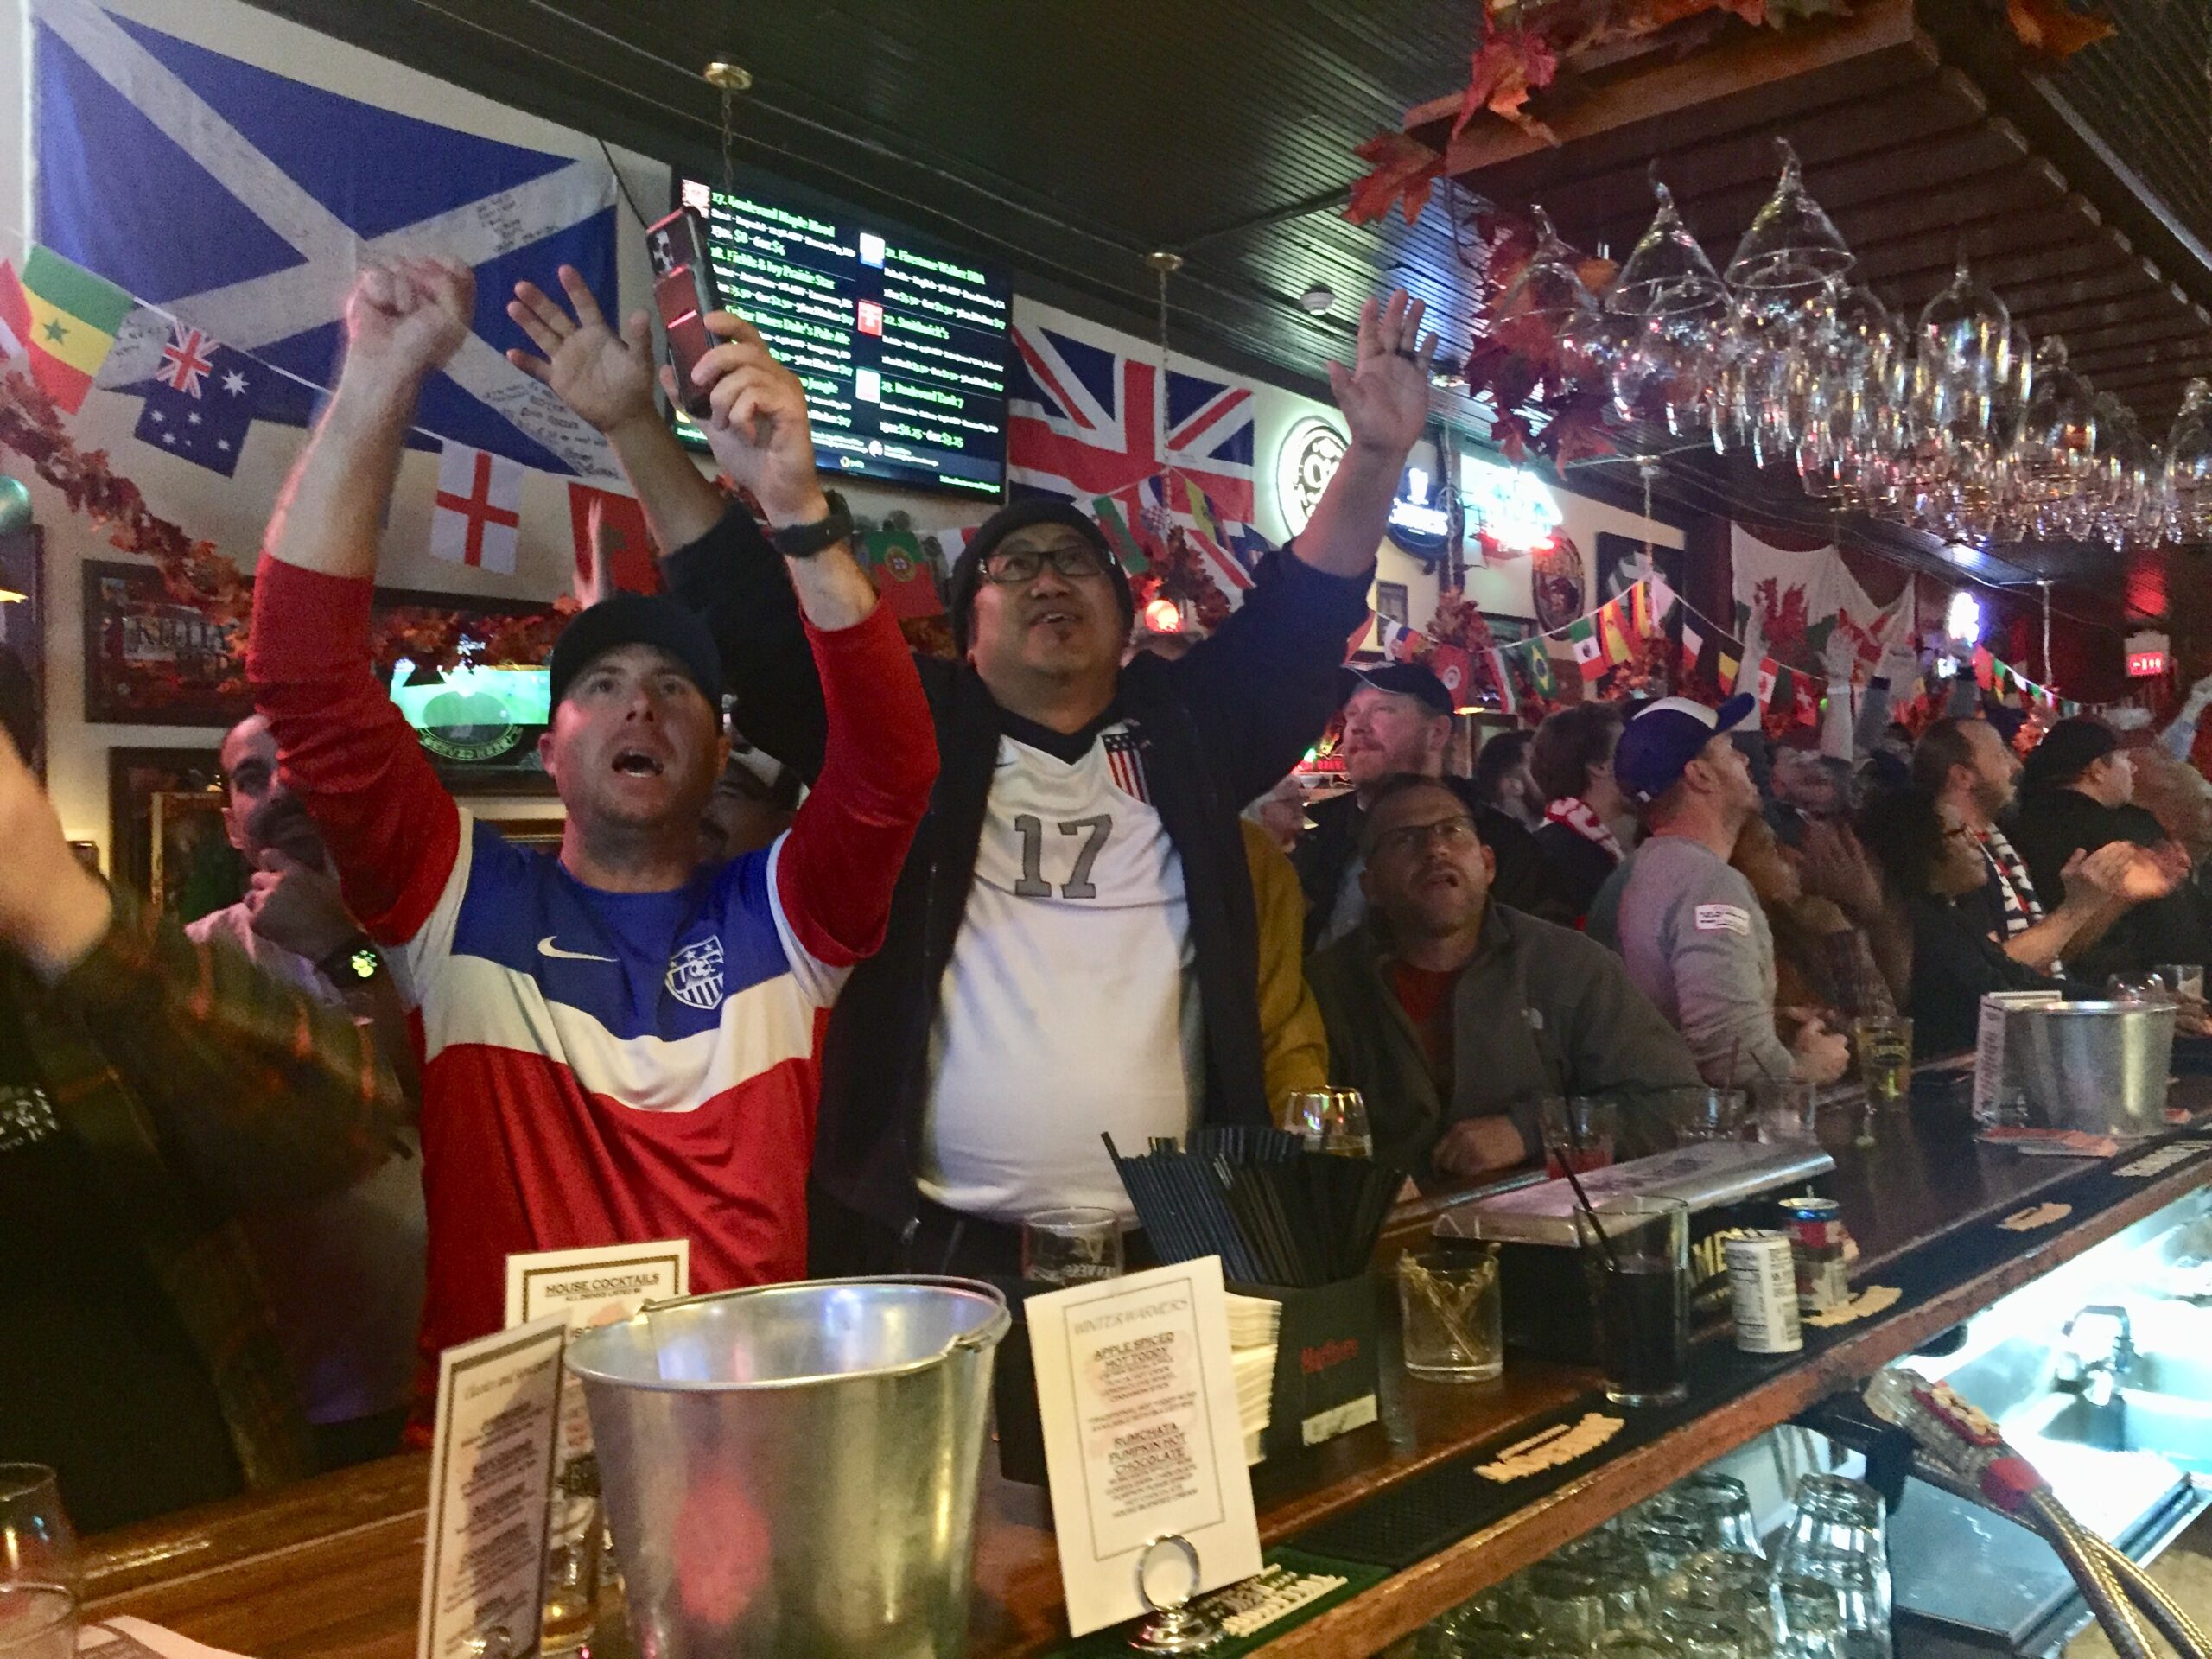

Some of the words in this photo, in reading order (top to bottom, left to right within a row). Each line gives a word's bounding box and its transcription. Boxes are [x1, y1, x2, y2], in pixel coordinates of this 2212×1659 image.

[1014, 813, 1113, 899] 17
[545, 1281, 589, 1296] HOUSE
[592, 1273, 660, 1291] COCKTAILS
[1094, 1342, 1133, 1363] APPLE
[1133, 1331, 1175, 1351] SPICED
[1105, 1356, 1128, 1370] HOT
[1129, 1345, 1169, 1365] TODDY
[1108, 1441, 1161, 1465] PUMPKIN
[1164, 1431, 1188, 1447] HOT
[1114, 1422, 1178, 1449] RUMCHATA
[1114, 1447, 1186, 1476] CHOCOLATE
